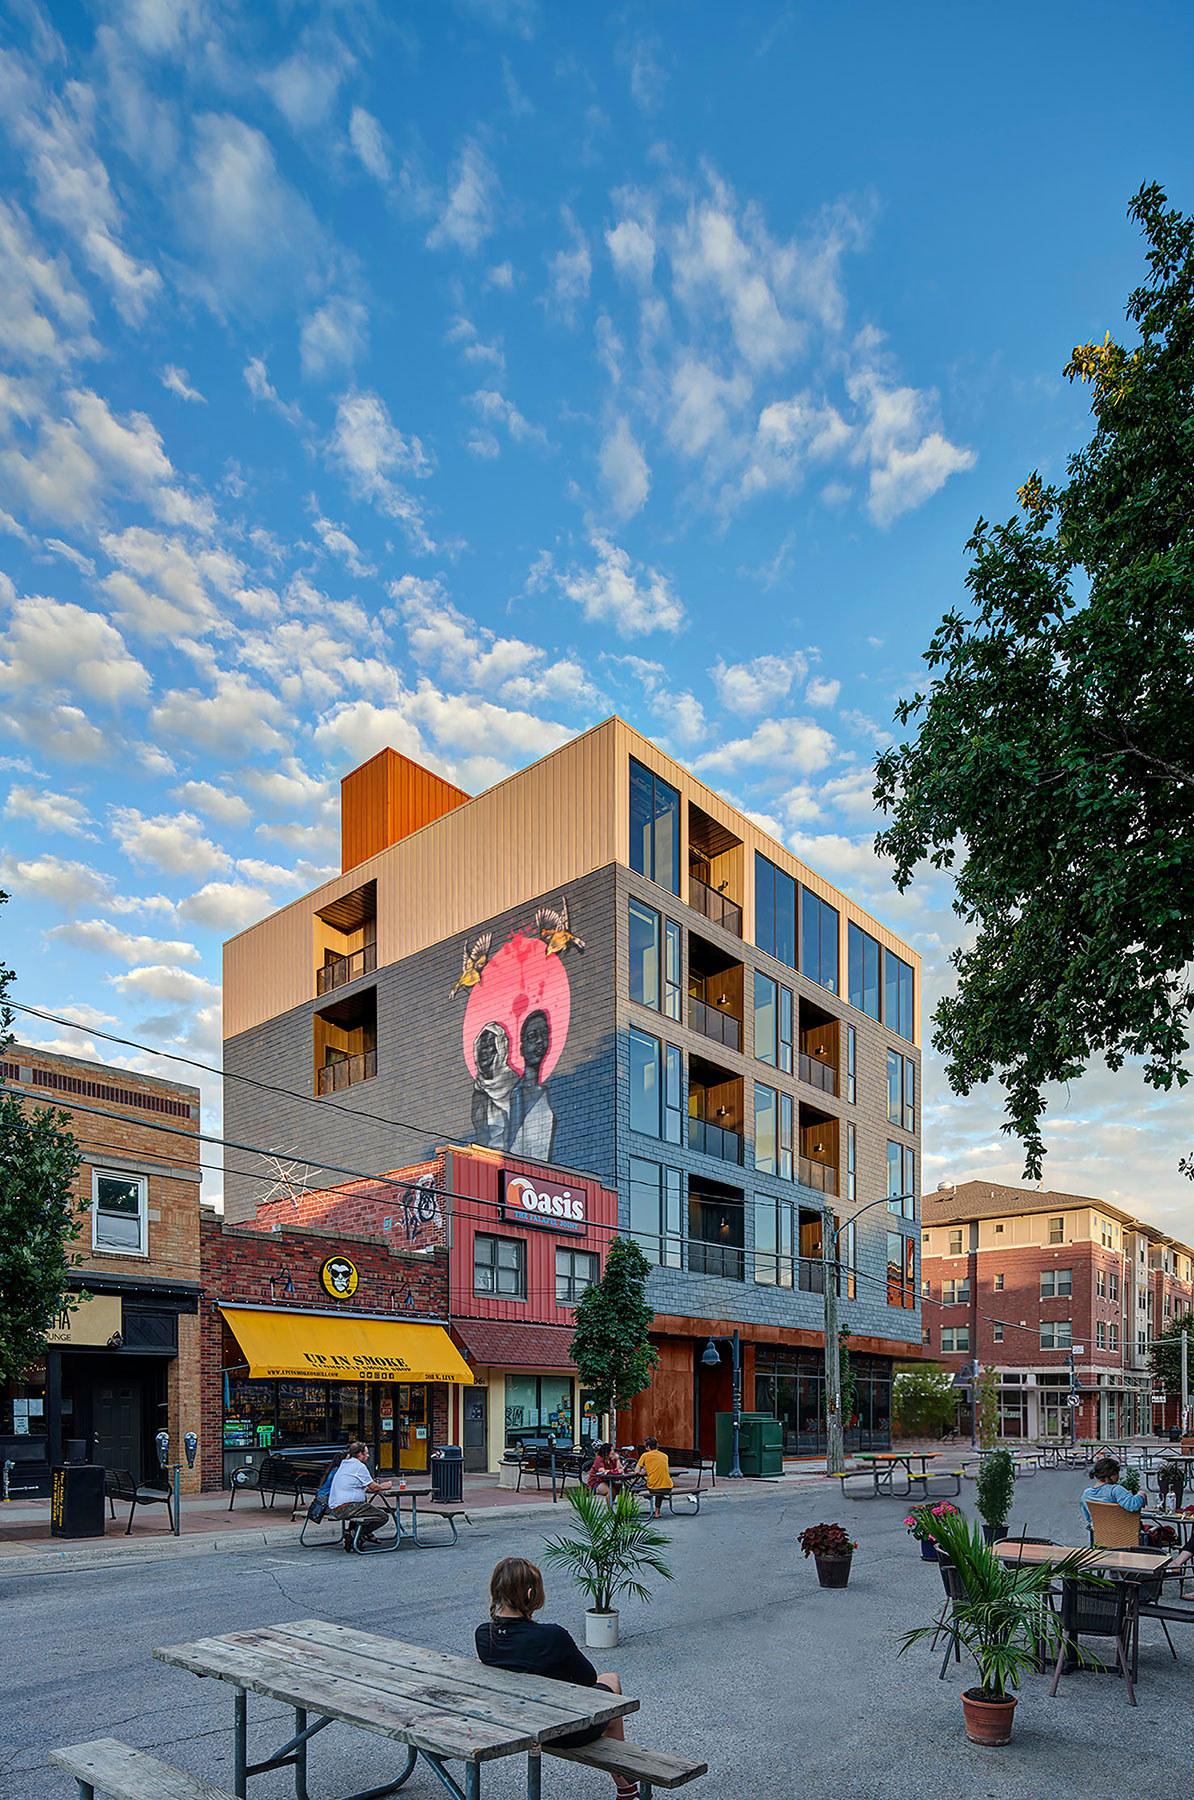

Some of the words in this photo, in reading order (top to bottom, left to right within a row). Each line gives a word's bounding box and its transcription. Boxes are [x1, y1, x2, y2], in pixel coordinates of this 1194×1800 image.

[514, 1211, 528, 1220] THE
[530, 1214, 558, 1226] FALAFEL
[560, 1221, 578, 1230] JOINT
[303, 1352, 327, 1364] UP
[330, 1355, 351, 1365] IN
[353, 1355, 408, 1367] SMOKE
